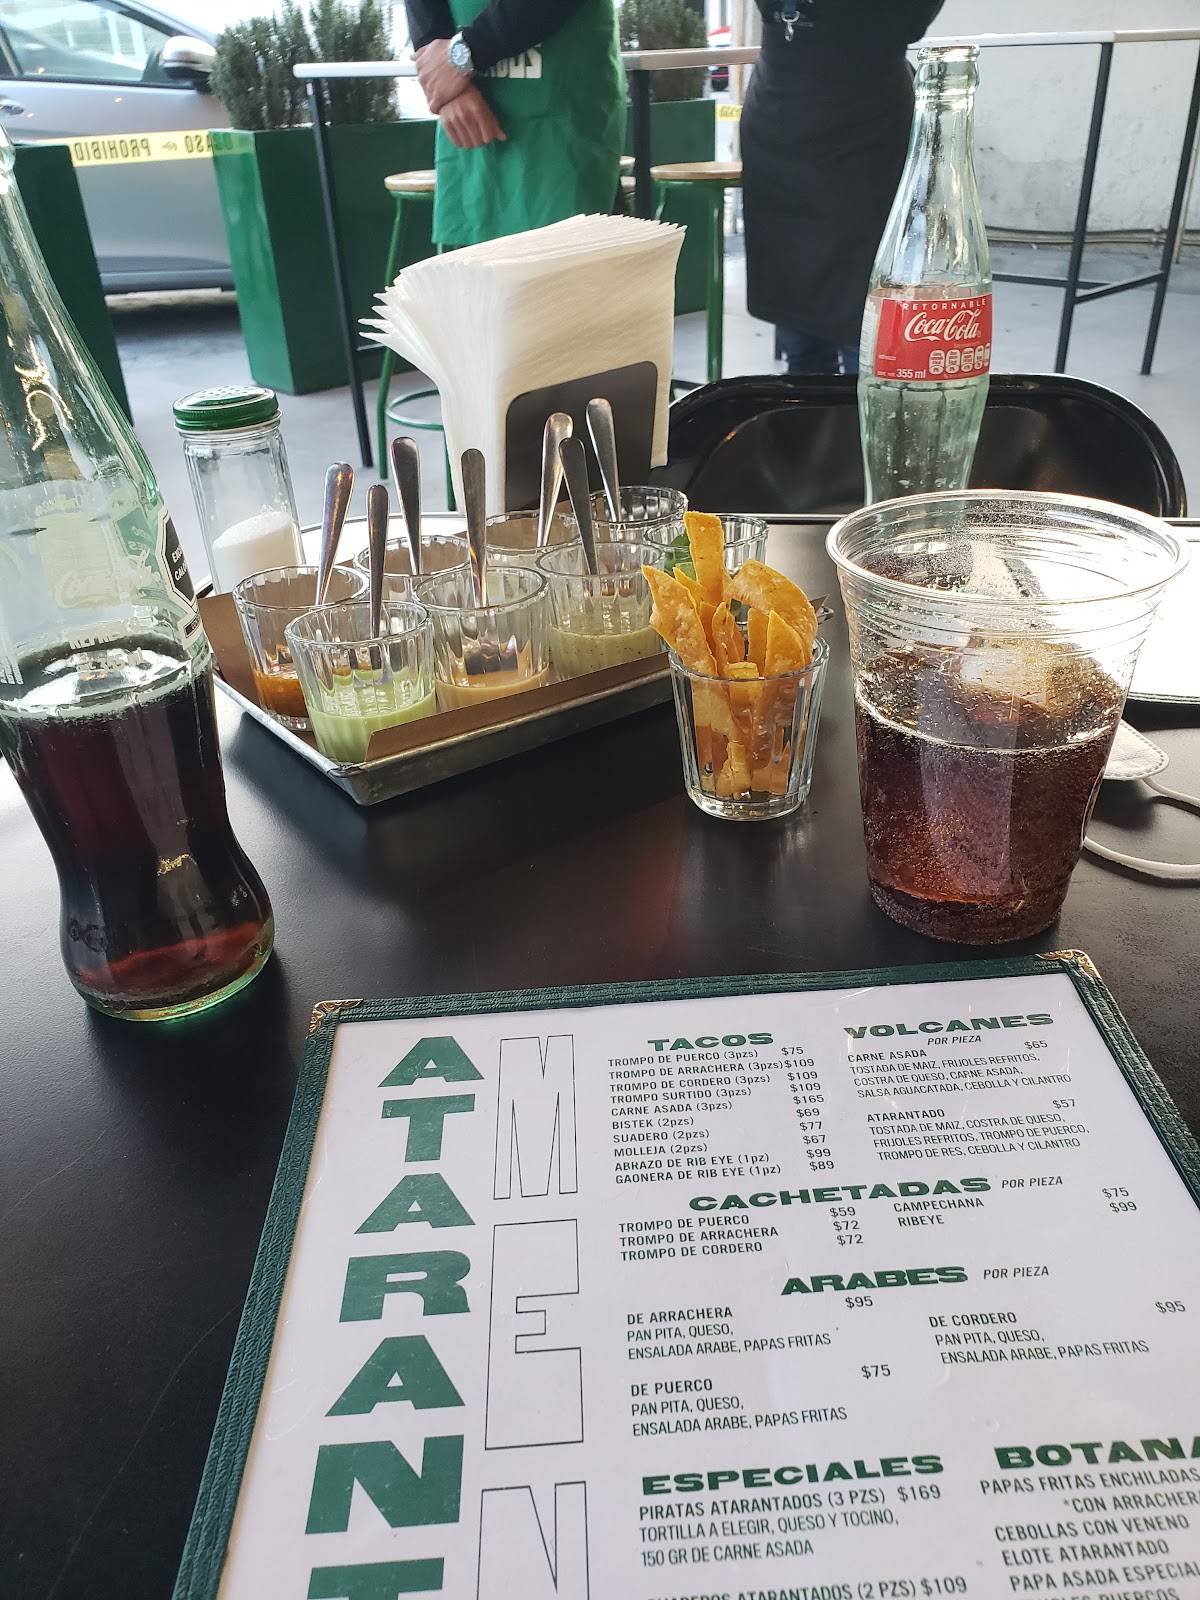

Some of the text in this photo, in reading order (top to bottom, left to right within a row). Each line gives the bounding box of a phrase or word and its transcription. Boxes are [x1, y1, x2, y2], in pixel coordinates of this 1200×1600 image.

[902, 298, 986, 311] RETORNABLE
[904, 309, 981, 342] Coca-Cola
[896, 369, 913, 379] 355
[914, 369, 926, 379] ml
[843, 1013, 1054, 1039] VOLCANES
[647, 1032, 774, 1052] TACOS
[927, 1035, 982, 1046] POR PIEZA
[1023, 1040, 1048, 1050] $65
[608, 1046, 804, 1067] TROMPO DE PUERCO (3pzs) $75
[847, 1049, 927, 1063] CARNE ASADA
[849, 1063, 897, 1075] TOSTADA
[897, 1062, 912, 1072] DE
[941, 1057, 988, 1069] FRIJOLES
[988, 1053, 1040, 1065] REFRITOS,
[609, 1058, 815, 1080] TROMPO DE ARRACHERA (3pzs) $109
[609, 1071, 818, 1092] TROMPO DE CORDERO (3pzs) $109
[857, 1074, 1072, 1098] SALSA AGUACATADA, CEBOLLA Y CILANTRO
[610, 1082, 821, 1104] TROMPO SURTIDO (3pzs) $109
[611, 1094, 824, 1117] CARNE ASADA (3pzs) $165
[1052, 1098, 1075, 1111] $57
[612, 1108, 820, 1130] BISTEK (2pzs) $69
[867, 1108, 945, 1122] ATARANTADO
[613, 1121, 822, 1143] SUADERO (2pzs) $77
[614, 1134, 826, 1157] MOLLEJA (2pzs) $67
[615, 1148, 831, 1172] ABRAZO DE RIB EYE (1pz) $99
[615, 1160, 834, 1184] GAONERA DE RIB EYE (1pz) $89
[1001, 1176, 1063, 1189] POR PIEZA
[689, 1177, 991, 1211] CACHETADAS
[1102, 1187, 1129, 1199] $75
[829, 1206, 856, 1218] $59
[893, 1197, 984, 1212] CAMPECHANA
[1109, 1201, 1137, 1214] $99
[618, 1214, 749, 1233] TROMPO DE PUERCO
[833, 1220, 860, 1232] $72
[897, 1214, 944, 1227] RIBEYE
[619, 1226, 779, 1247] TROMPO DE ARRACHERA
[836, 1233, 864, 1247] $72
[620, 1241, 763, 1261] TROMPO DE CORDERO
[780, 1266, 968, 1296] ARABES
[983, 1266, 1049, 1280] POR PIEZA
[845, 1296, 873, 1310] $95
[1155, 1301, 1186, 1314] $95
[627, 1306, 733, 1325] DE ARRACHERA
[928, 1312, 1017, 1328] DE CORDERO
[627, 1323, 733, 1342] PAN PITA, QUESO,
[935, 1329, 1045, 1346] PAN PITA, QUESO,
[628, 1333, 831, 1360] ENSALADA ARABE, PAPAS FRITAS
[940, 1340, 1149, 1364] ENSALADA ARABE, PAPAS FRITAS
[861, 1364, 891, 1380] $75
[631, 1378, 713, 1397] DE PUERCO
[631, 1396, 744, 1416] PAN PITA, QUESO,
[632, 1407, 848, 1437] ENSALADA ARABE, PAPAS FRITAS
[642, 1455, 944, 1496] ESPECIALES
[980, 1467, 1200, 1495] PAPAS FRITAS ENCHILADAS
[639, 1502, 705, 1521] PIRATAS
[711, 1493, 823, 1516] ATARANTADOS
[897, 1484, 941, 1502] $169
[639, 1509, 899, 1543] TORTILLA A ELEGIR, QUESO Y TOCINO,
[994, 1514, 1189, 1542] CEBOLLAS CON VENENO
[641, 1539, 814, 1567] 150 GR DE CARNE ASADA
[1001, 1539, 1169, 1567] ELOTE ATARANTADO
